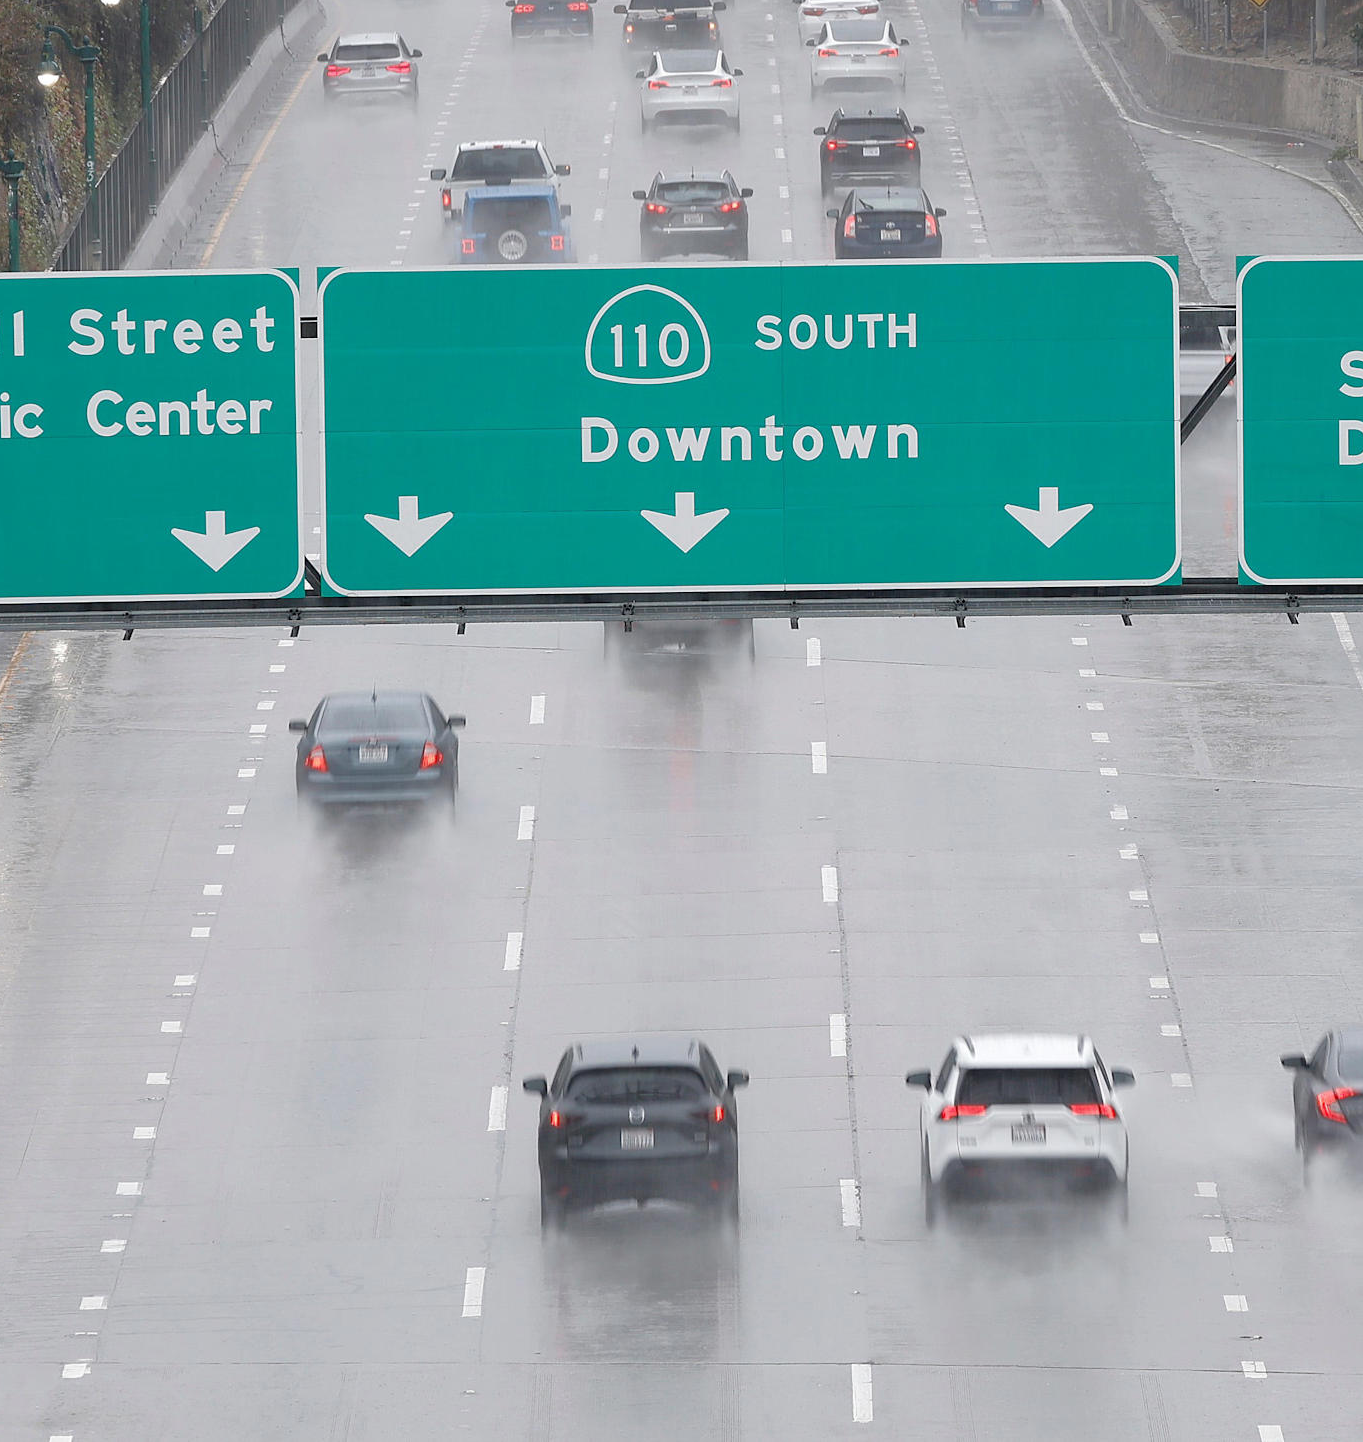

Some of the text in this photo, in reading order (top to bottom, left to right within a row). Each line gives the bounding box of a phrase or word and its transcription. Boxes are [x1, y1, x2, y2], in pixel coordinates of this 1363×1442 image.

[67, 305, 275, 356] Street
[610, 322, 690, 368] 110
[754, 312, 917, 351] SOUTH
[86, 388, 273, 437] Center
[580, 414, 919, 463] Downtown
